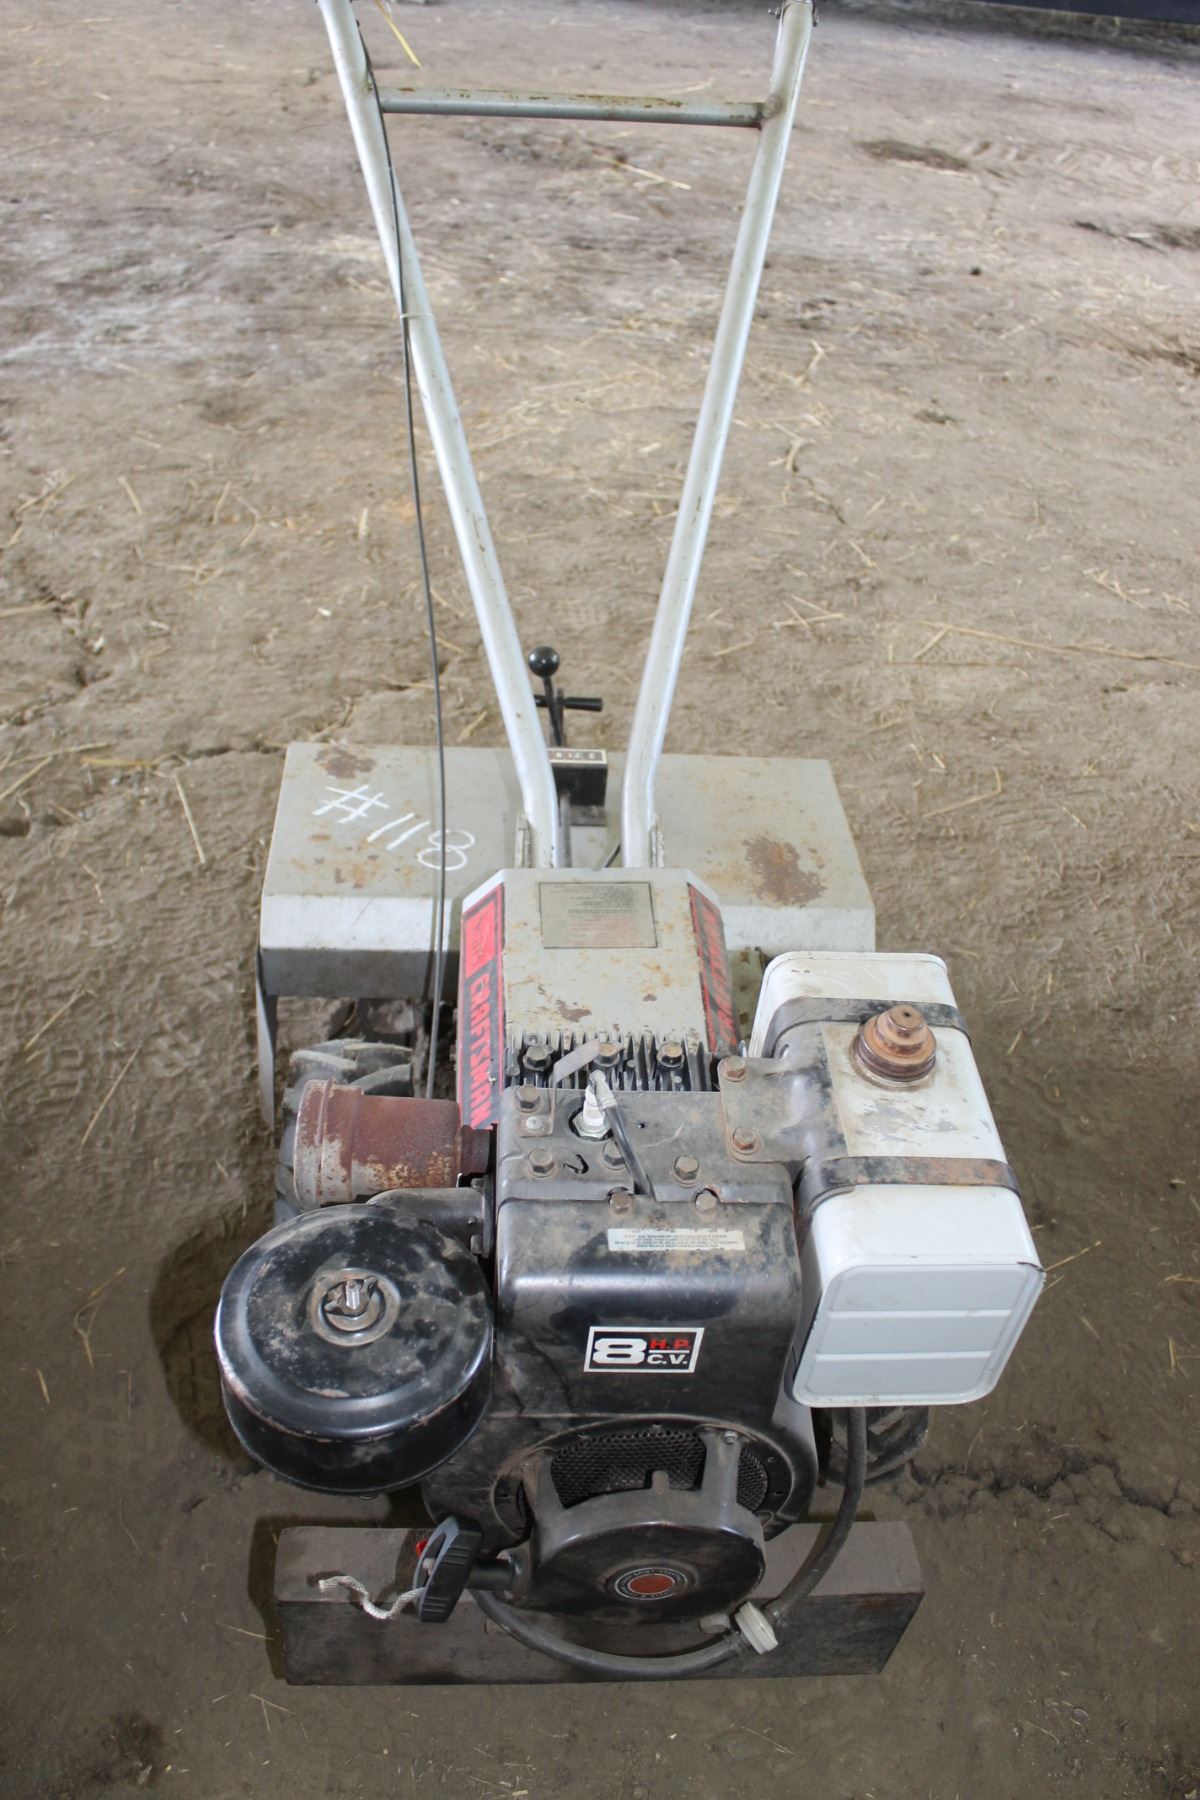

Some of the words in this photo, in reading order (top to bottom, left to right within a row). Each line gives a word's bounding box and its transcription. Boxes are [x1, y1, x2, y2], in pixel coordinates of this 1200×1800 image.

[312, 784, 476, 871] #118
[469, 972, 492, 1130] CRAFTSMAN
[592, 1337, 648, 1365] 8
[649, 1338, 691, 1350] H.P.
[646, 1354, 688, 1365] C.V.
